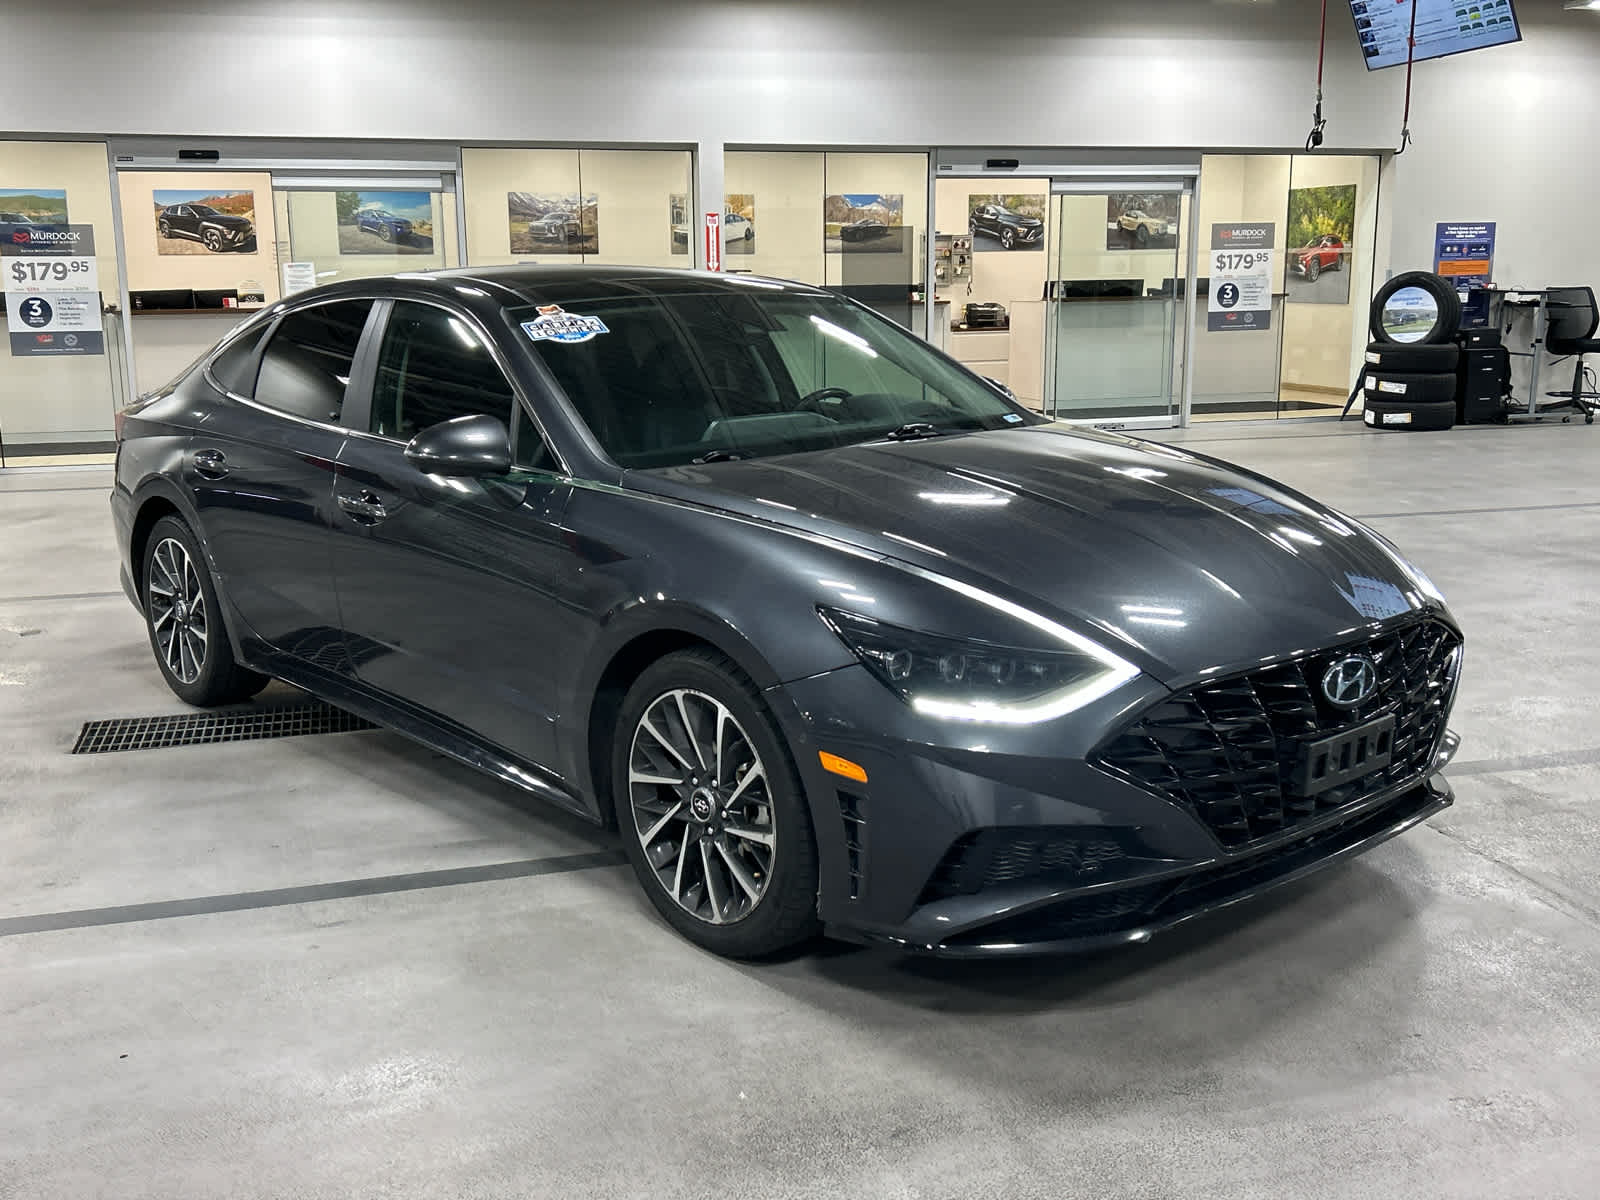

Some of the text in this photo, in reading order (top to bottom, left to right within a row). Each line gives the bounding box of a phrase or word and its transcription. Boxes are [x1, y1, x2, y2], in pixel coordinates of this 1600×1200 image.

[30, 232, 80, 240] MURDOCK
[1216, 252, 1269, 272] $179.95
[11, 260, 89, 283] $179.95
[1224, 285, 1233, 299] 3
[29, 300, 42, 316] 3
